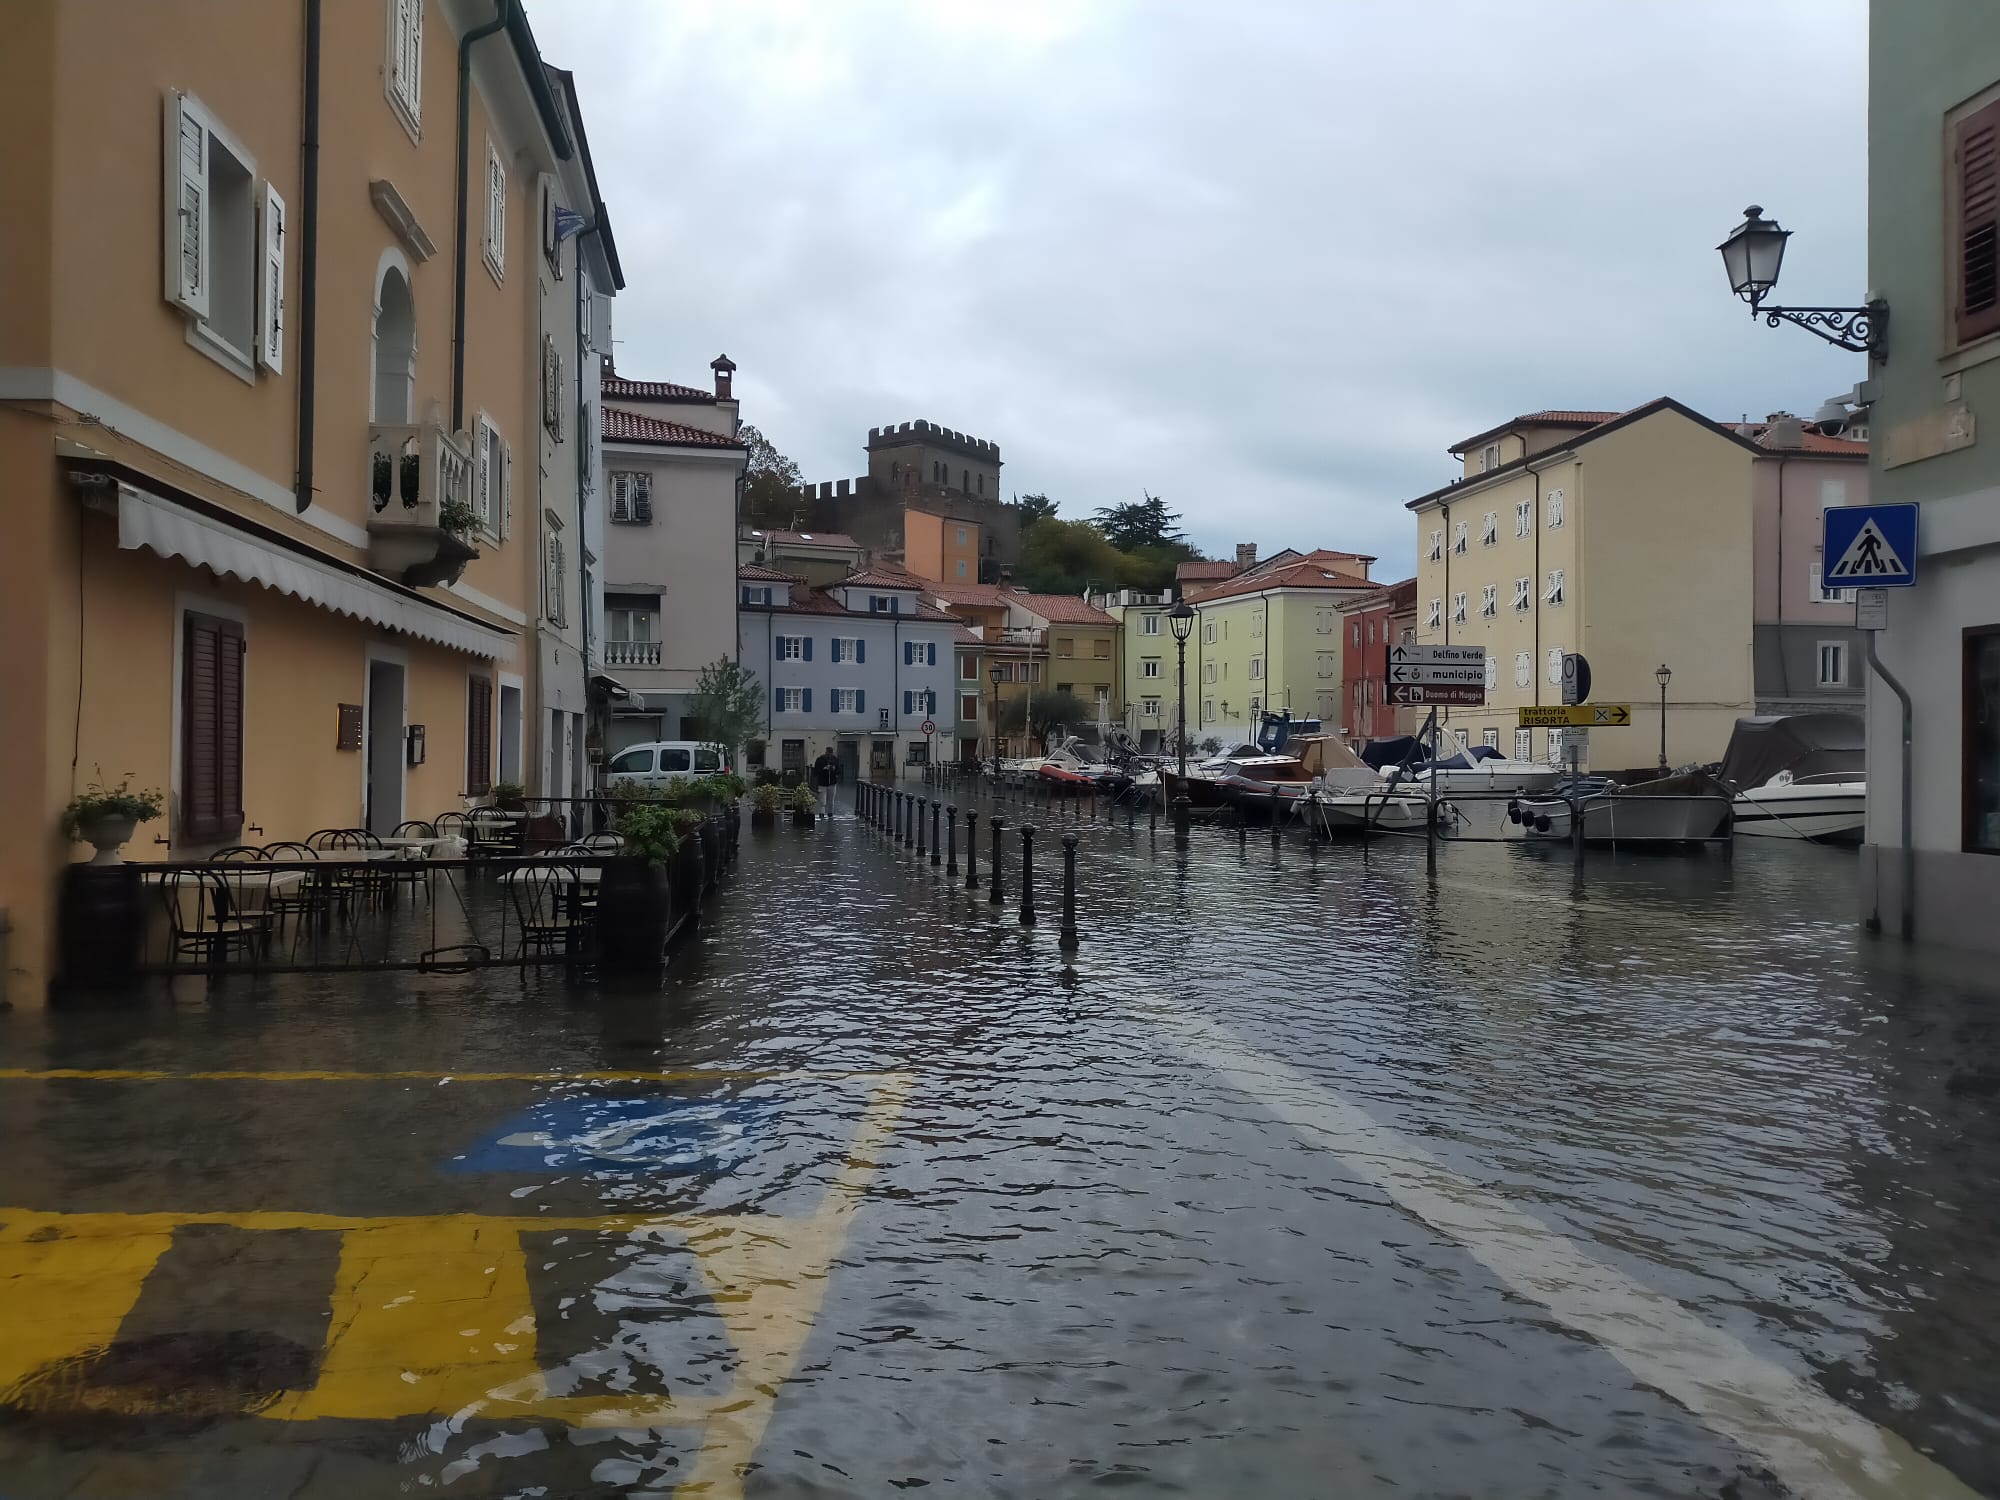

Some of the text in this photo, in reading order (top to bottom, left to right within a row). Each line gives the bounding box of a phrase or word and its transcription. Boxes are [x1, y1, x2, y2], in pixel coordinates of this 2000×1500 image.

[1433, 650, 1483, 660] Delfino Verde
[1432, 669, 1483, 681] municipio
[1425, 690, 1482, 701] Duomo di Muggia
[1523, 716, 1570, 725] RISORTA
